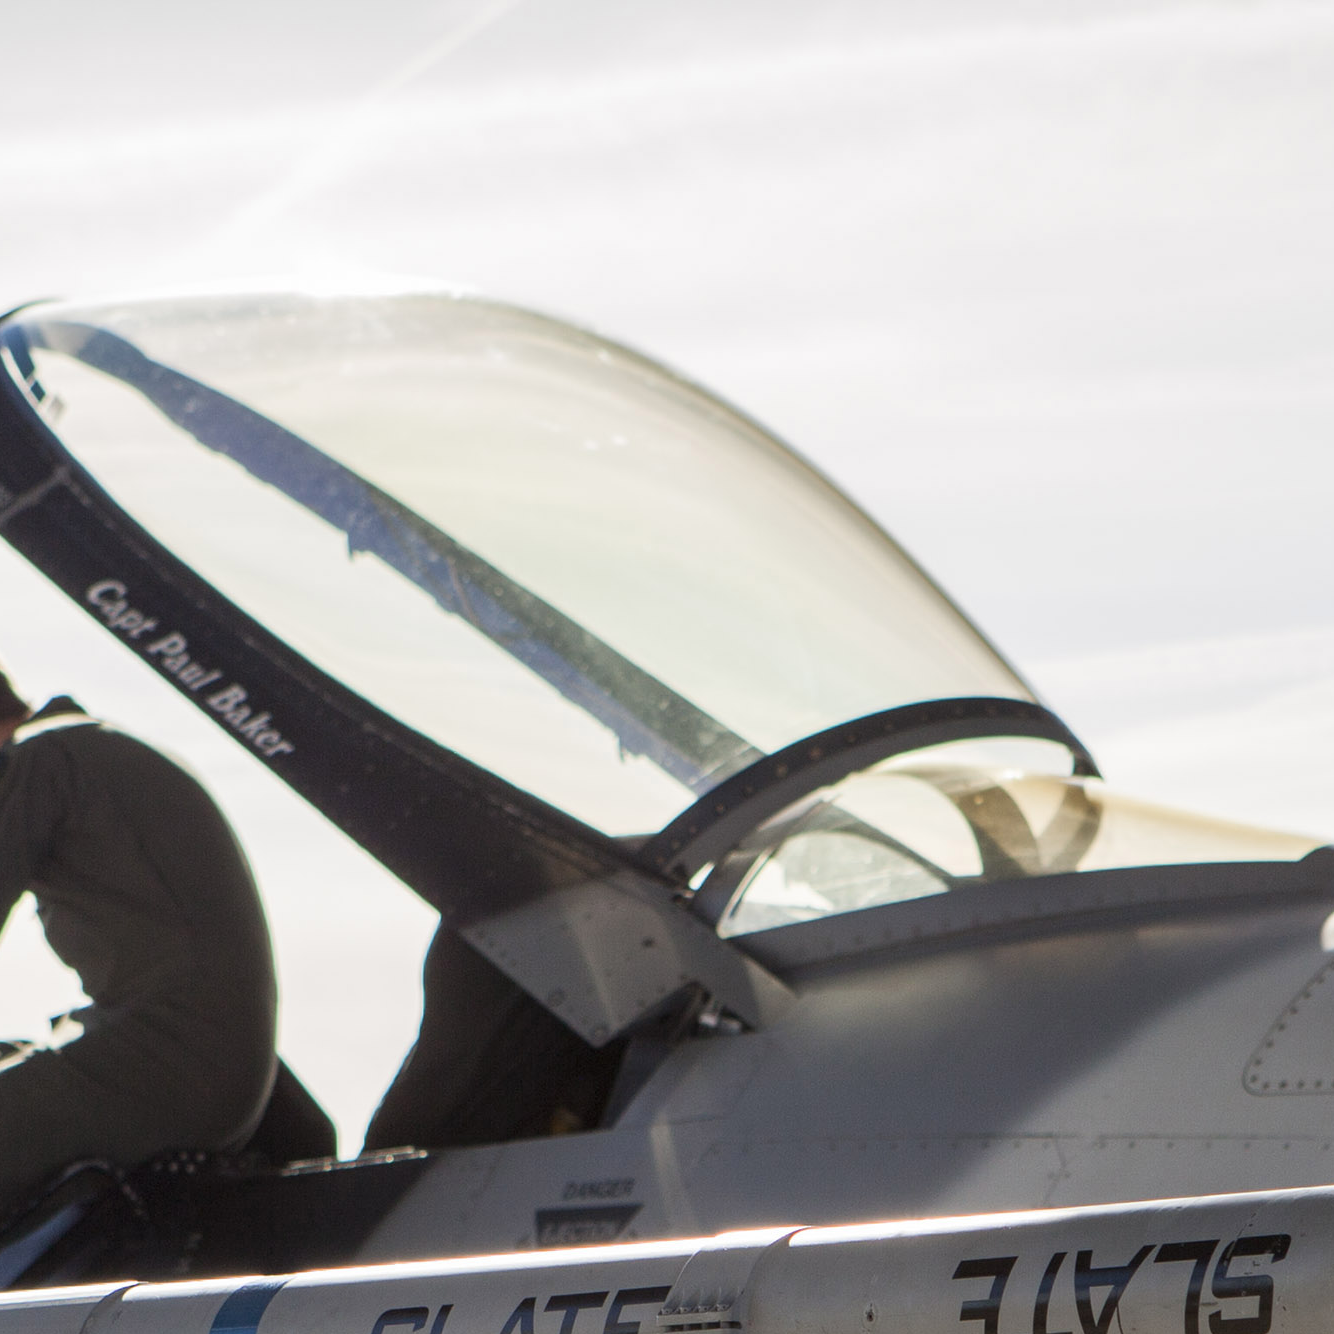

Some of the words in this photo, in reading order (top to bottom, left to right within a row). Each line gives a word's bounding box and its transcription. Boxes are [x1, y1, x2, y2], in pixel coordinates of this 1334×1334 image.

[87, 579, 159, 639] Capt
[147, 631, 223, 692] Paul
[207, 683, 295, 757] Baker
